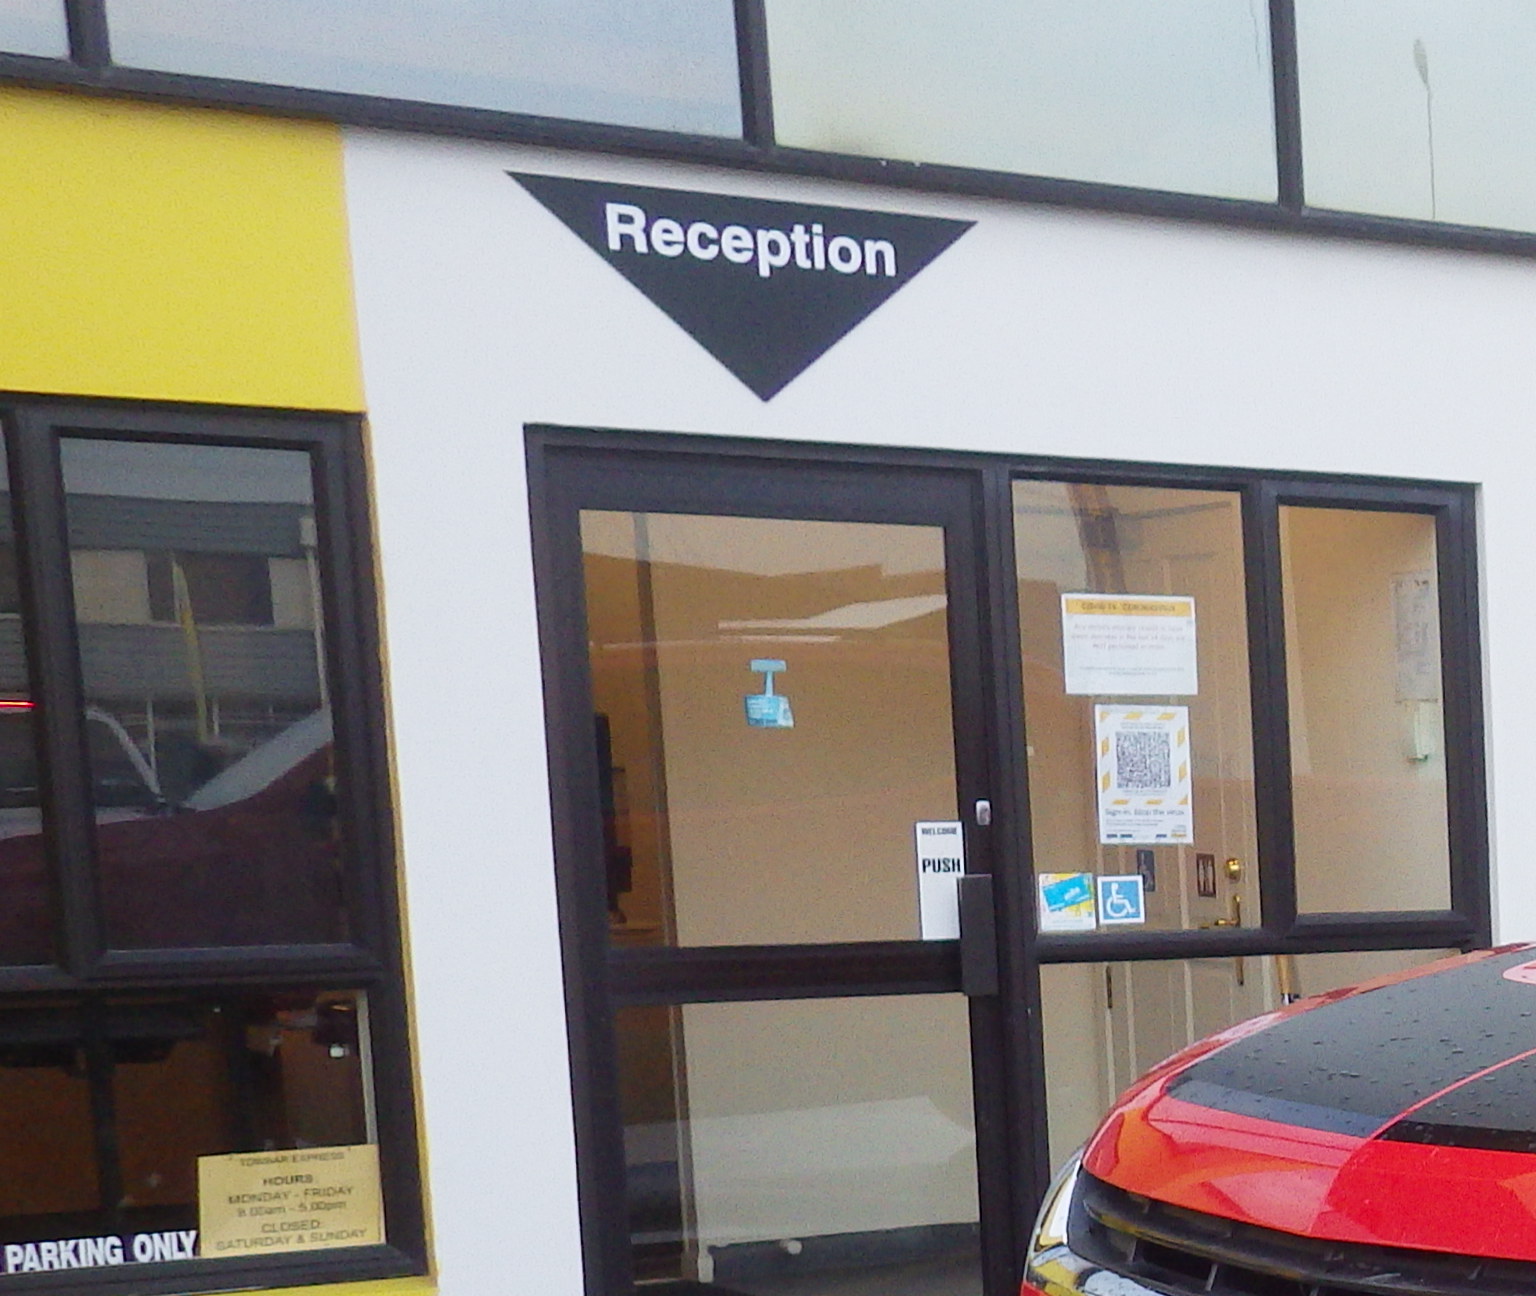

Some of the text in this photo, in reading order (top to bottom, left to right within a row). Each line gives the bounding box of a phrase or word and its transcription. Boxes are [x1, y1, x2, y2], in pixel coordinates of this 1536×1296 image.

[606, 203, 896, 278] Reception
[922, 858, 961, 874] PUSH
[263, 1174, 313, 1186] HOURS
[228, 1190, 290, 1204] MONDAY
[303, 1186, 354, 1199] FRIDAY
[261, 1219, 321, 1233] CLOSED
[215, 1235, 292, 1251] SATURDAY
[310, 1228, 367, 1242] SUNDAY
[4, 1230, 198, 1274] PARKING ONLY
